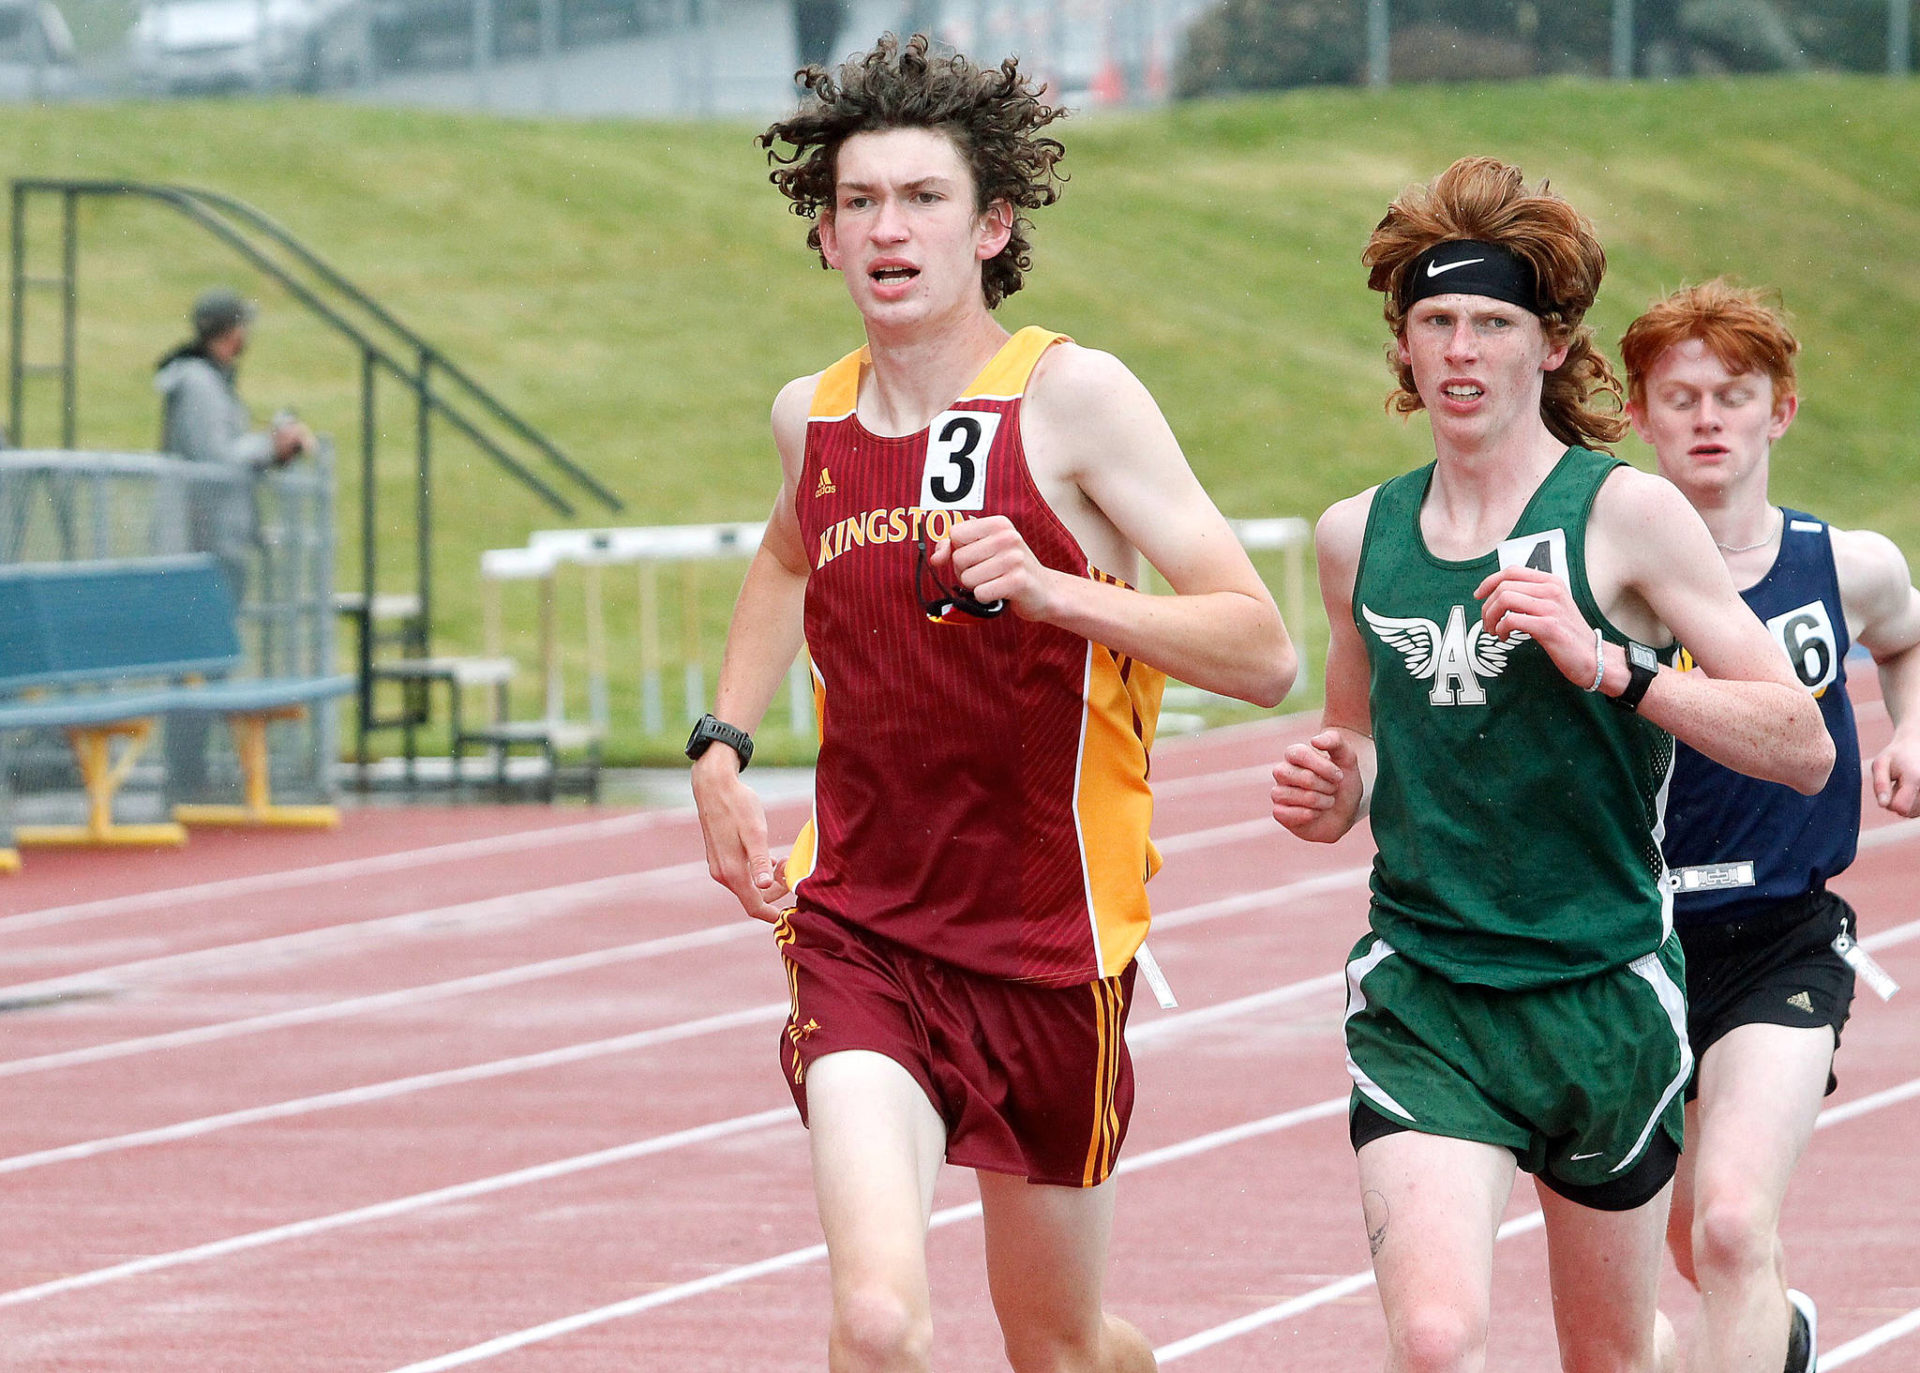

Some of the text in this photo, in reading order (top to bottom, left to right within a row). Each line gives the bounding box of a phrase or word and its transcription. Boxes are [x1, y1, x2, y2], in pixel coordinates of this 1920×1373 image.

[930, 416, 982, 503] 3
[1429, 605, 1487, 706] A
[1783, 613, 1830, 688] 6
